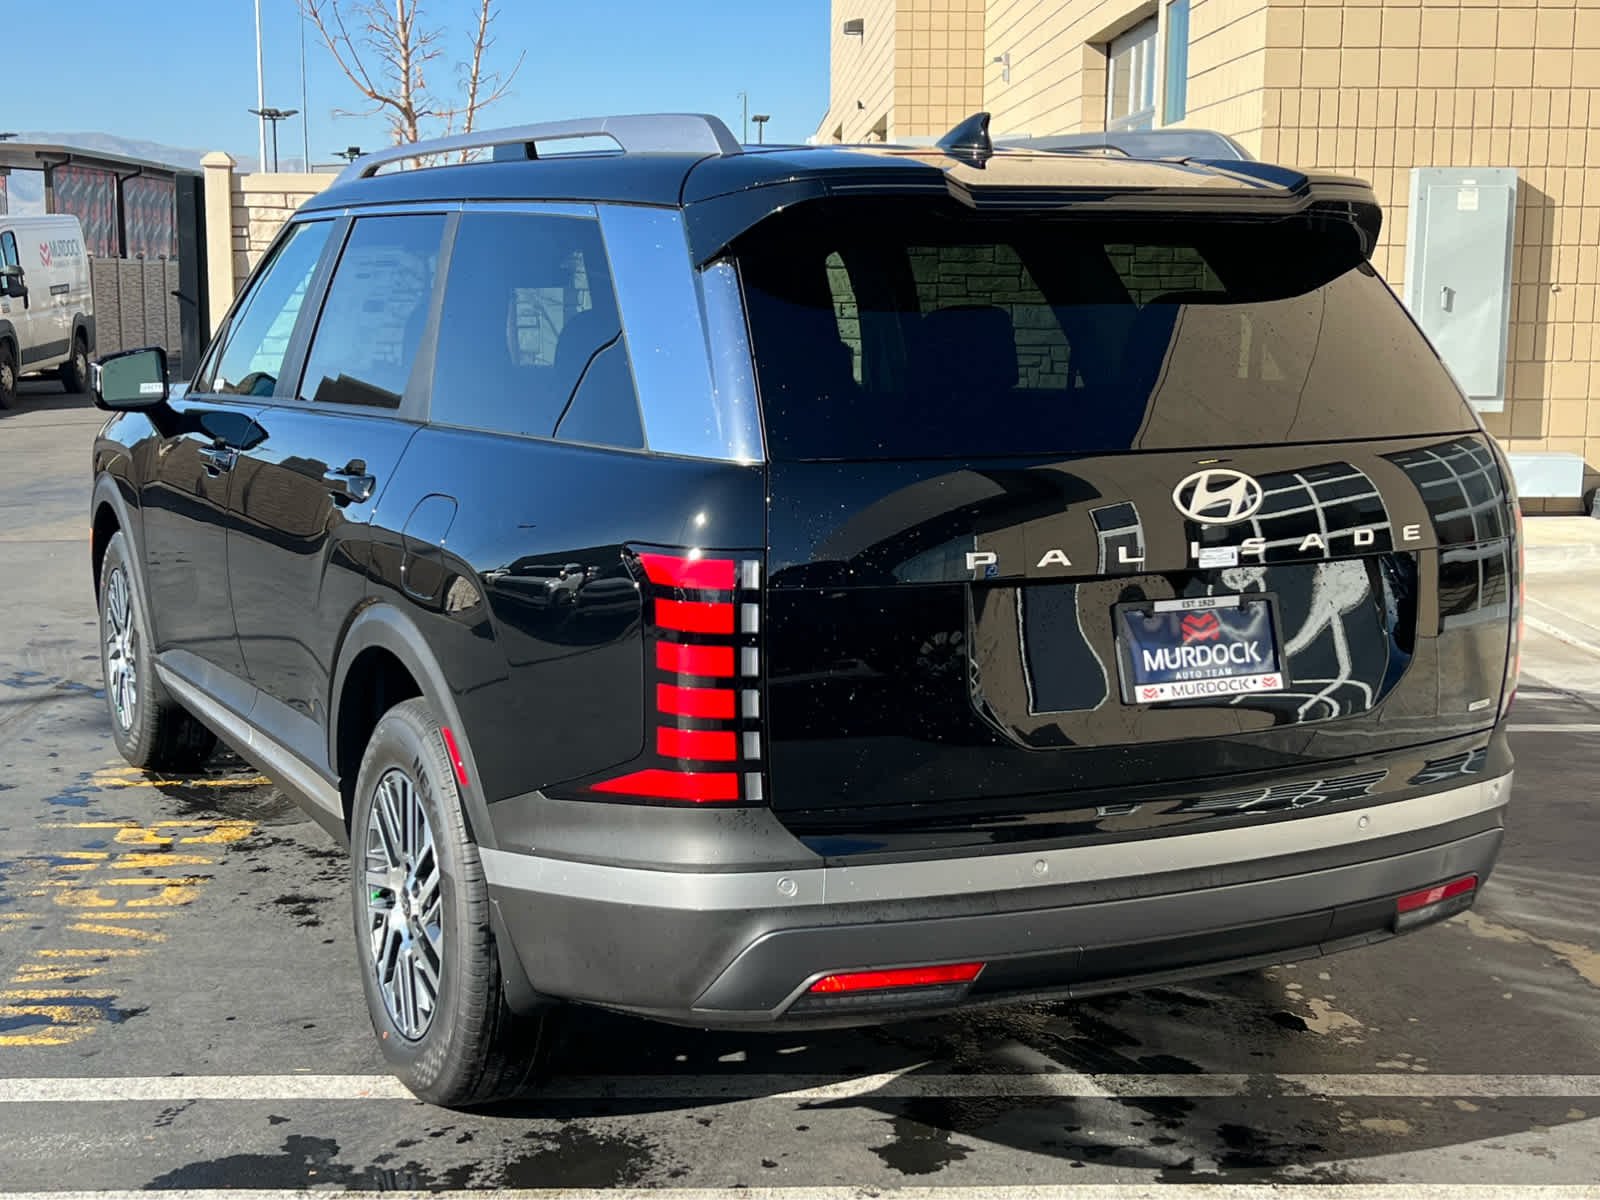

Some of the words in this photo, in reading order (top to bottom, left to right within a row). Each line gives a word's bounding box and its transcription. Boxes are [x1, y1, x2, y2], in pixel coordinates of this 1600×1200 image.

[965, 523, 1421, 571] PALISADE
[1142, 640, 1261, 672] MURDOCK
[1175, 669, 1203, 681] AUTO
[1206, 667, 1233, 678] TEAM
[1171, 679, 1251, 698] MURDOCK
